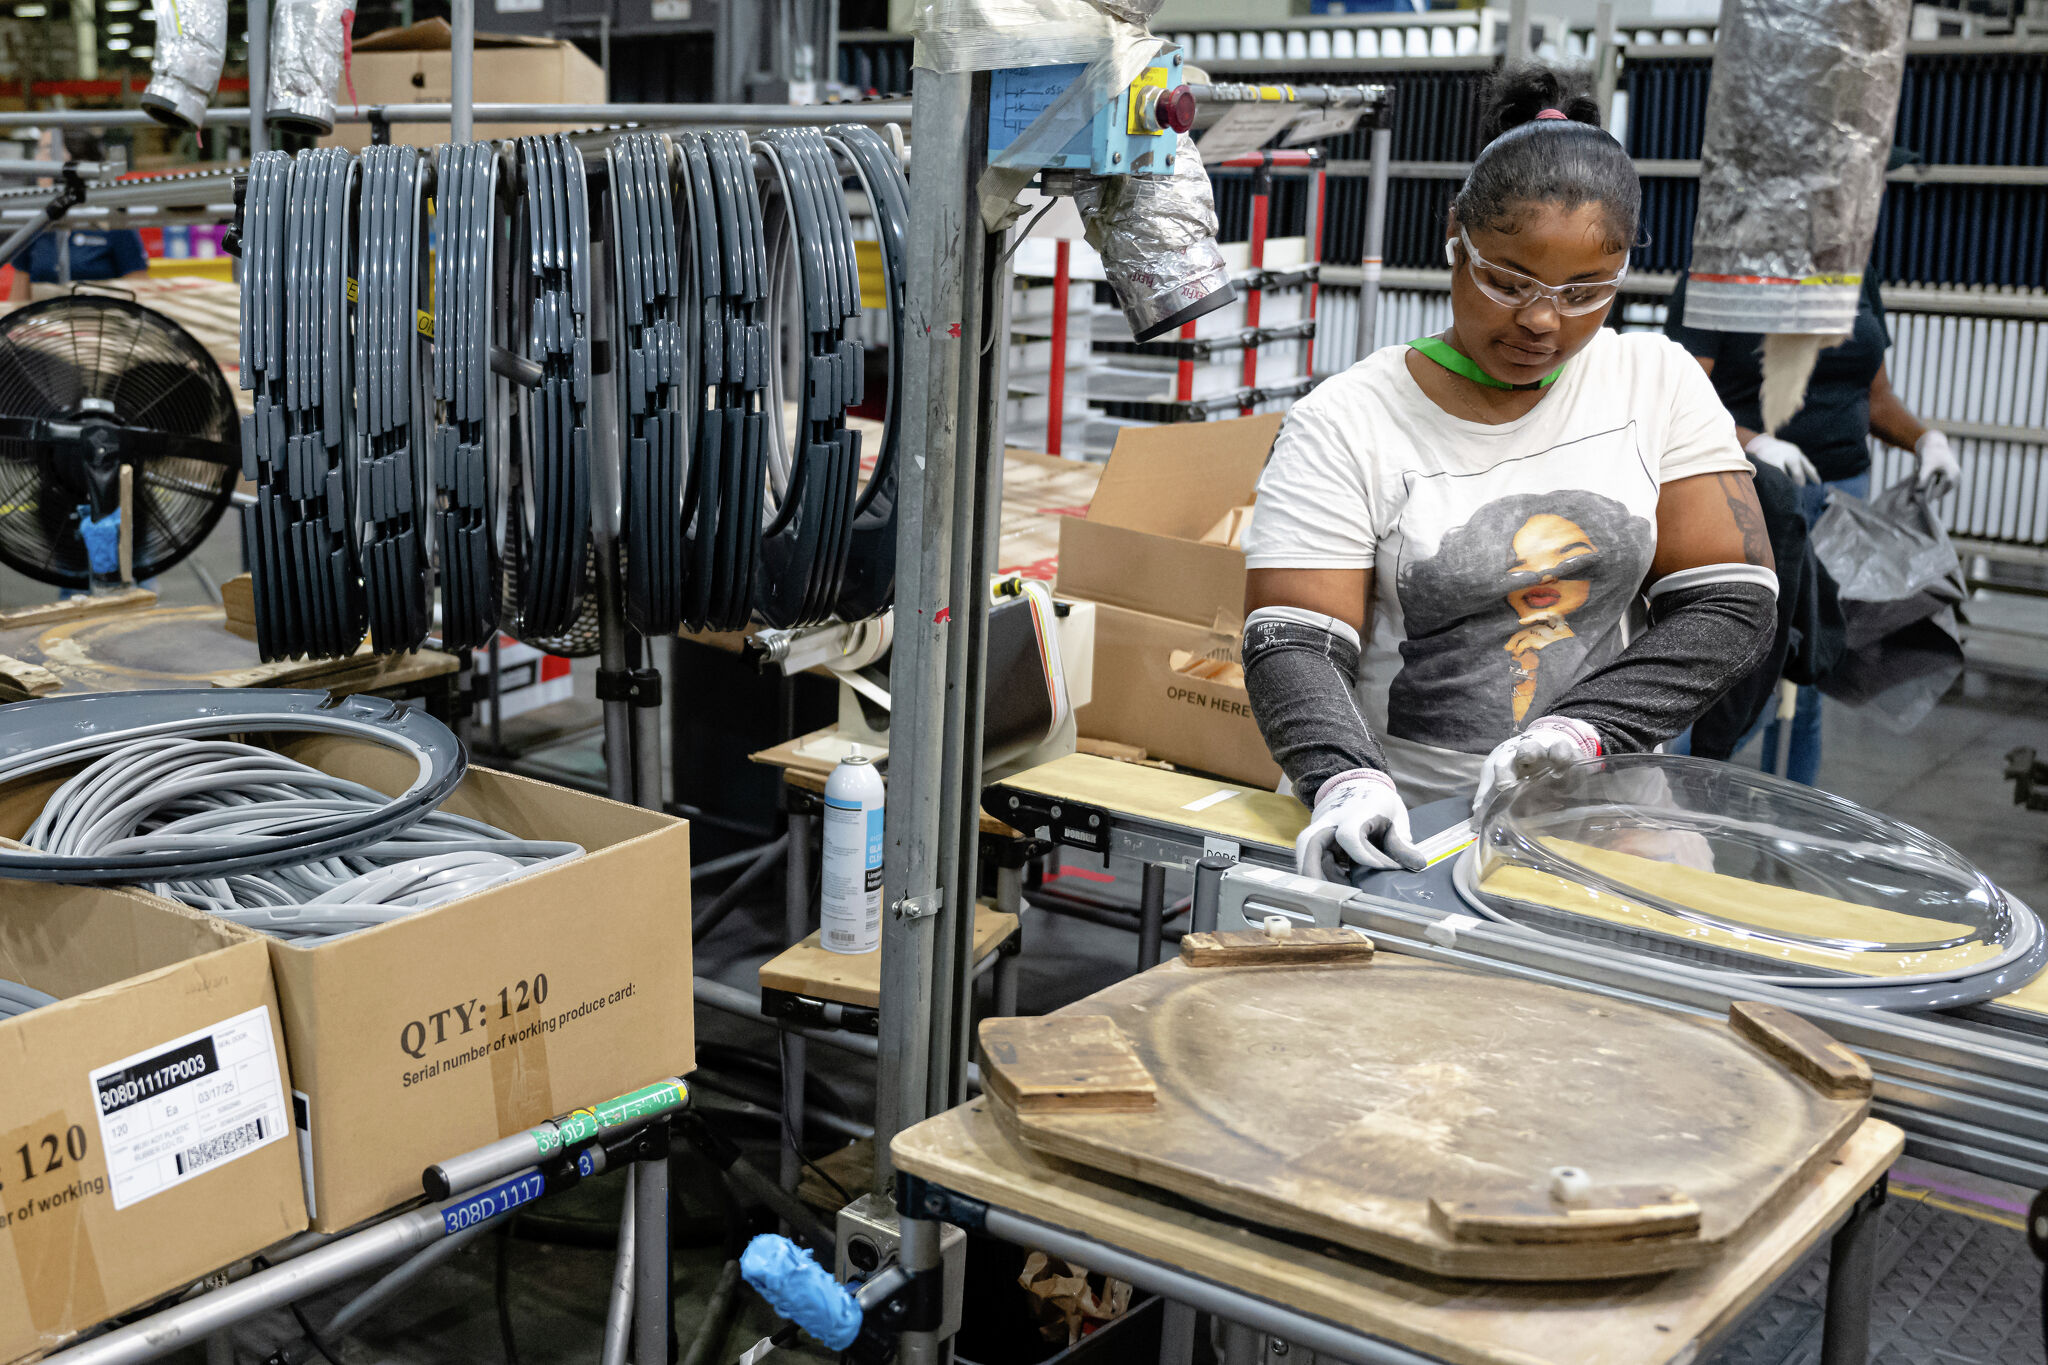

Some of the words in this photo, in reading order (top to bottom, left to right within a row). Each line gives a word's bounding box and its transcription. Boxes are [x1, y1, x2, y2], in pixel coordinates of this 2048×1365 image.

[1167, 686, 1207, 706] OPEN
[1211, 697, 1250, 718] HERE
[400, 998, 487, 1060] QTY:
[497, 973, 548, 1020] 120
[402, 1061, 440, 1088] Serial
[443, 1041, 491, 1071] number
[494, 1033, 506, 1051] of
[508, 1015, 556, 1045] working
[559, 998, 605, 1028] produce
[608, 982, 636, 1004] card:
[100, 1054, 206, 1111] 308D1117P003
[197, 1080, 235, 1104] 03/17/25
[111, 1122, 129, 1138] 120
[166, 1104, 179, 1118] Ea
[16, 1124, 87, 1182] 120
[18, 1199, 34, 1220] of
[37, 1176, 104, 1212] working
[447, 1197, 495, 1234] 308D
[500, 1175, 541, 1211] 1117
